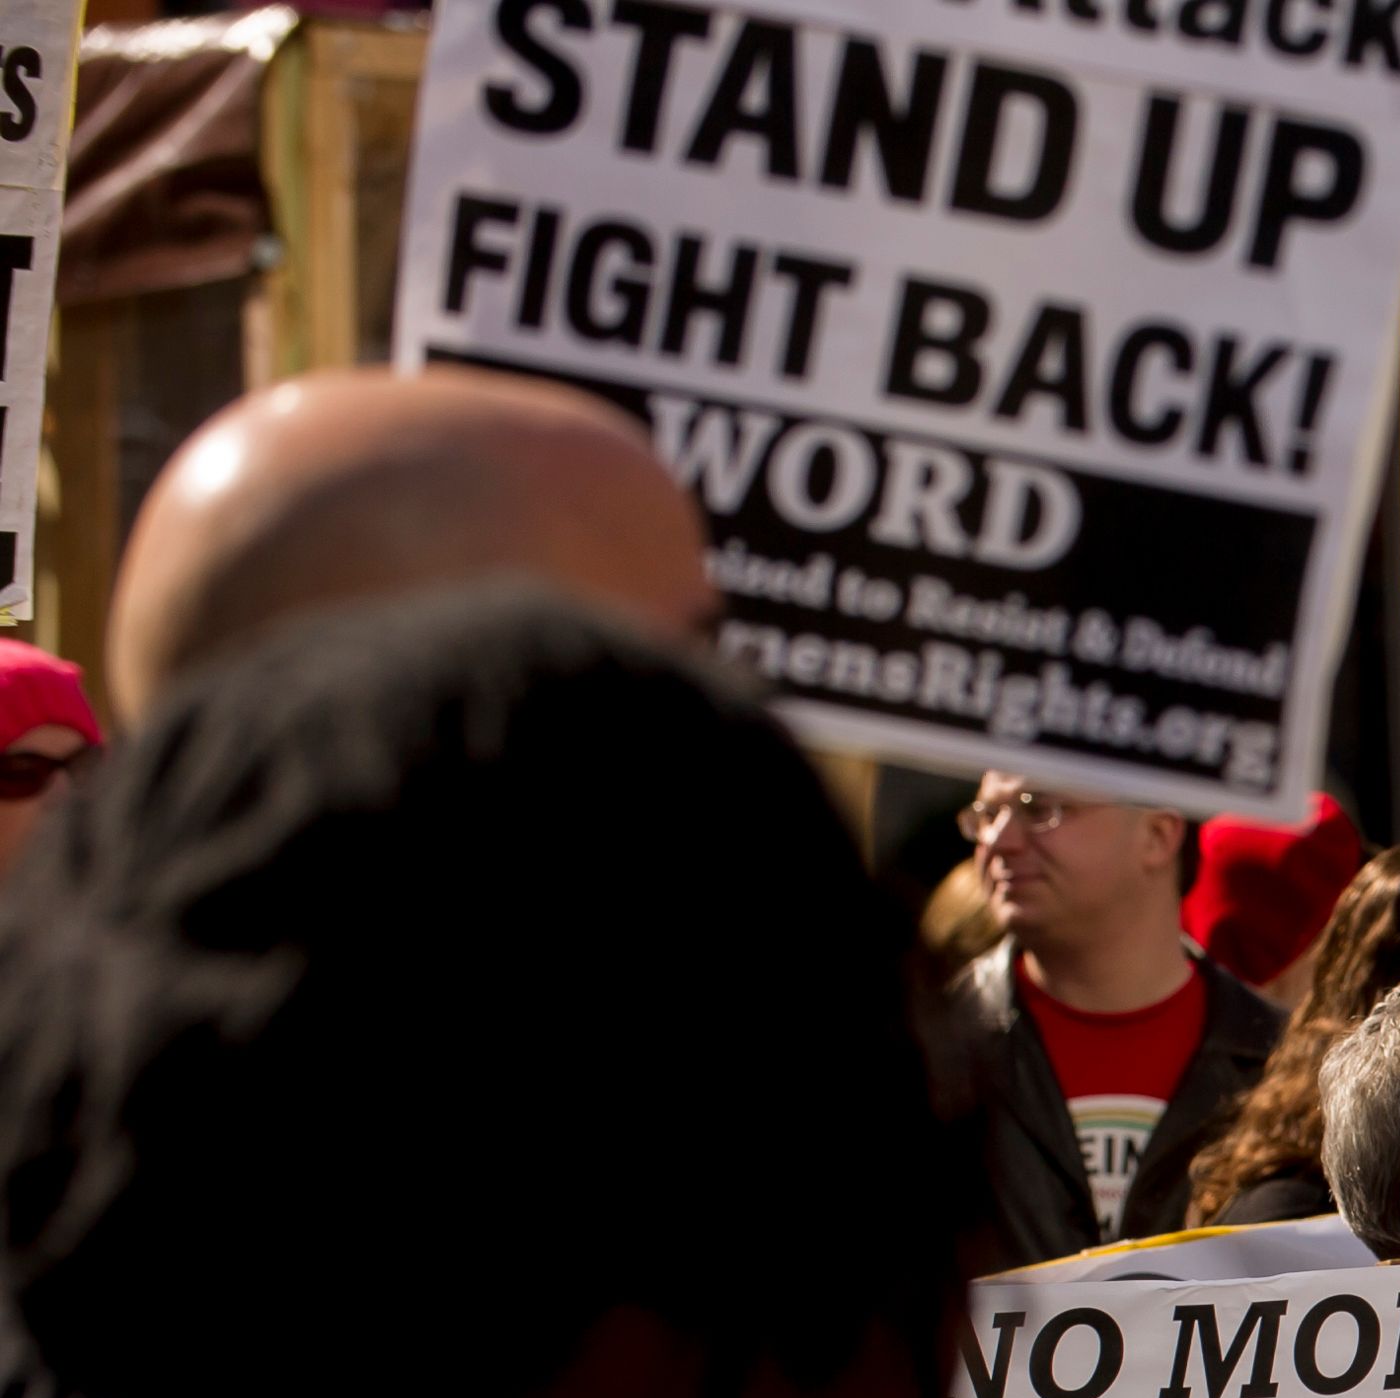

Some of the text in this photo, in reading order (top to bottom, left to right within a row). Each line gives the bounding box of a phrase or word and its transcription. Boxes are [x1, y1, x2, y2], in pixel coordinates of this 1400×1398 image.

[481, 0, 1369, 270] STAND UP
[442, 194, 1341, 476] FIGHT BACK!
[649, 393, 1082, 571] WORD
[838, 571, 904, 621] to
